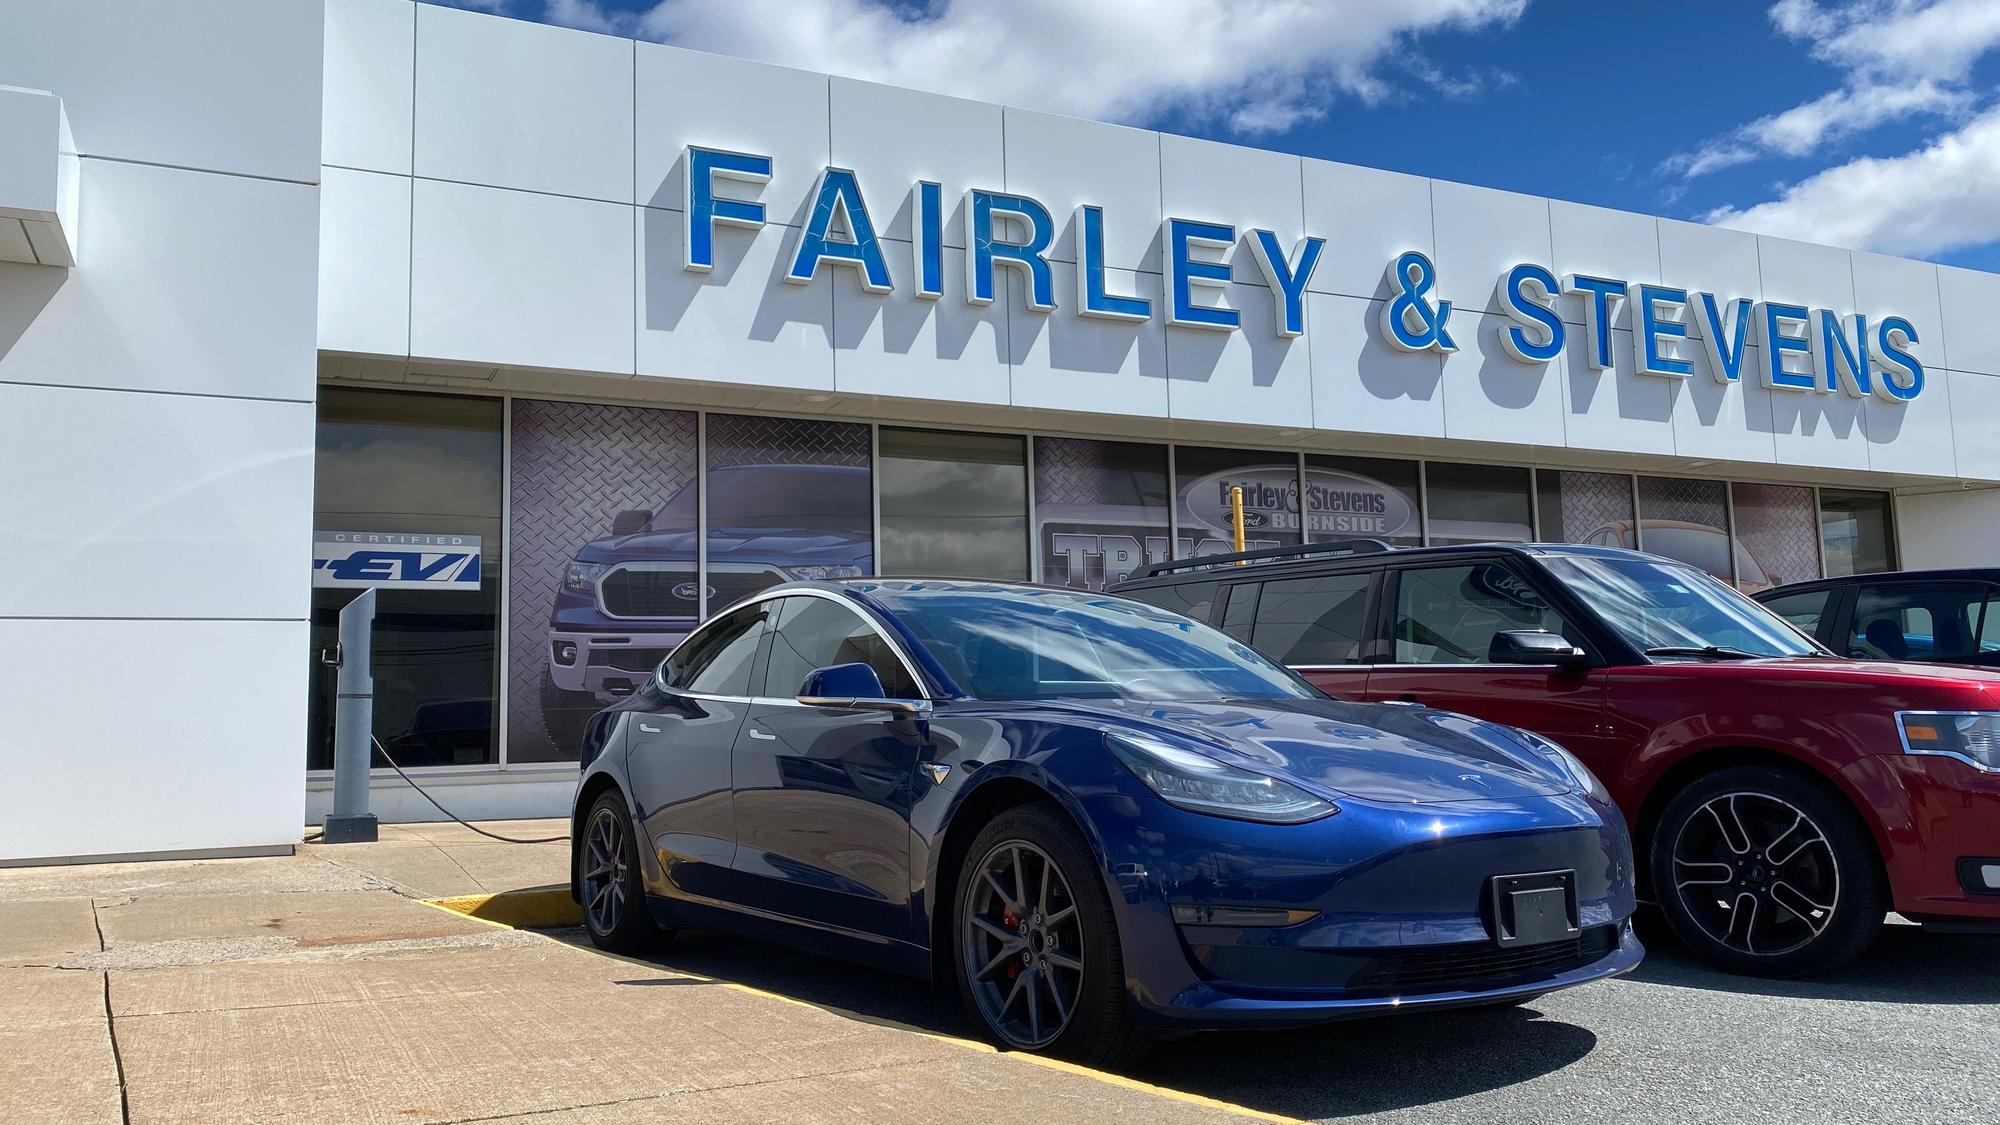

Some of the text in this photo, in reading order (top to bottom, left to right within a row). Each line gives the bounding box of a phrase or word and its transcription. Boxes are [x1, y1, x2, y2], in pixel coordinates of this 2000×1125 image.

[683, 144, 1925, 403] FAIRLEY & STEVENS
[1219, 480, 1287, 511] Firley
[1309, 485, 1386, 514] Stevens
[1271, 512, 1386, 533] BURNSIDE
[335, 533, 463, 545] CERTIFIED
